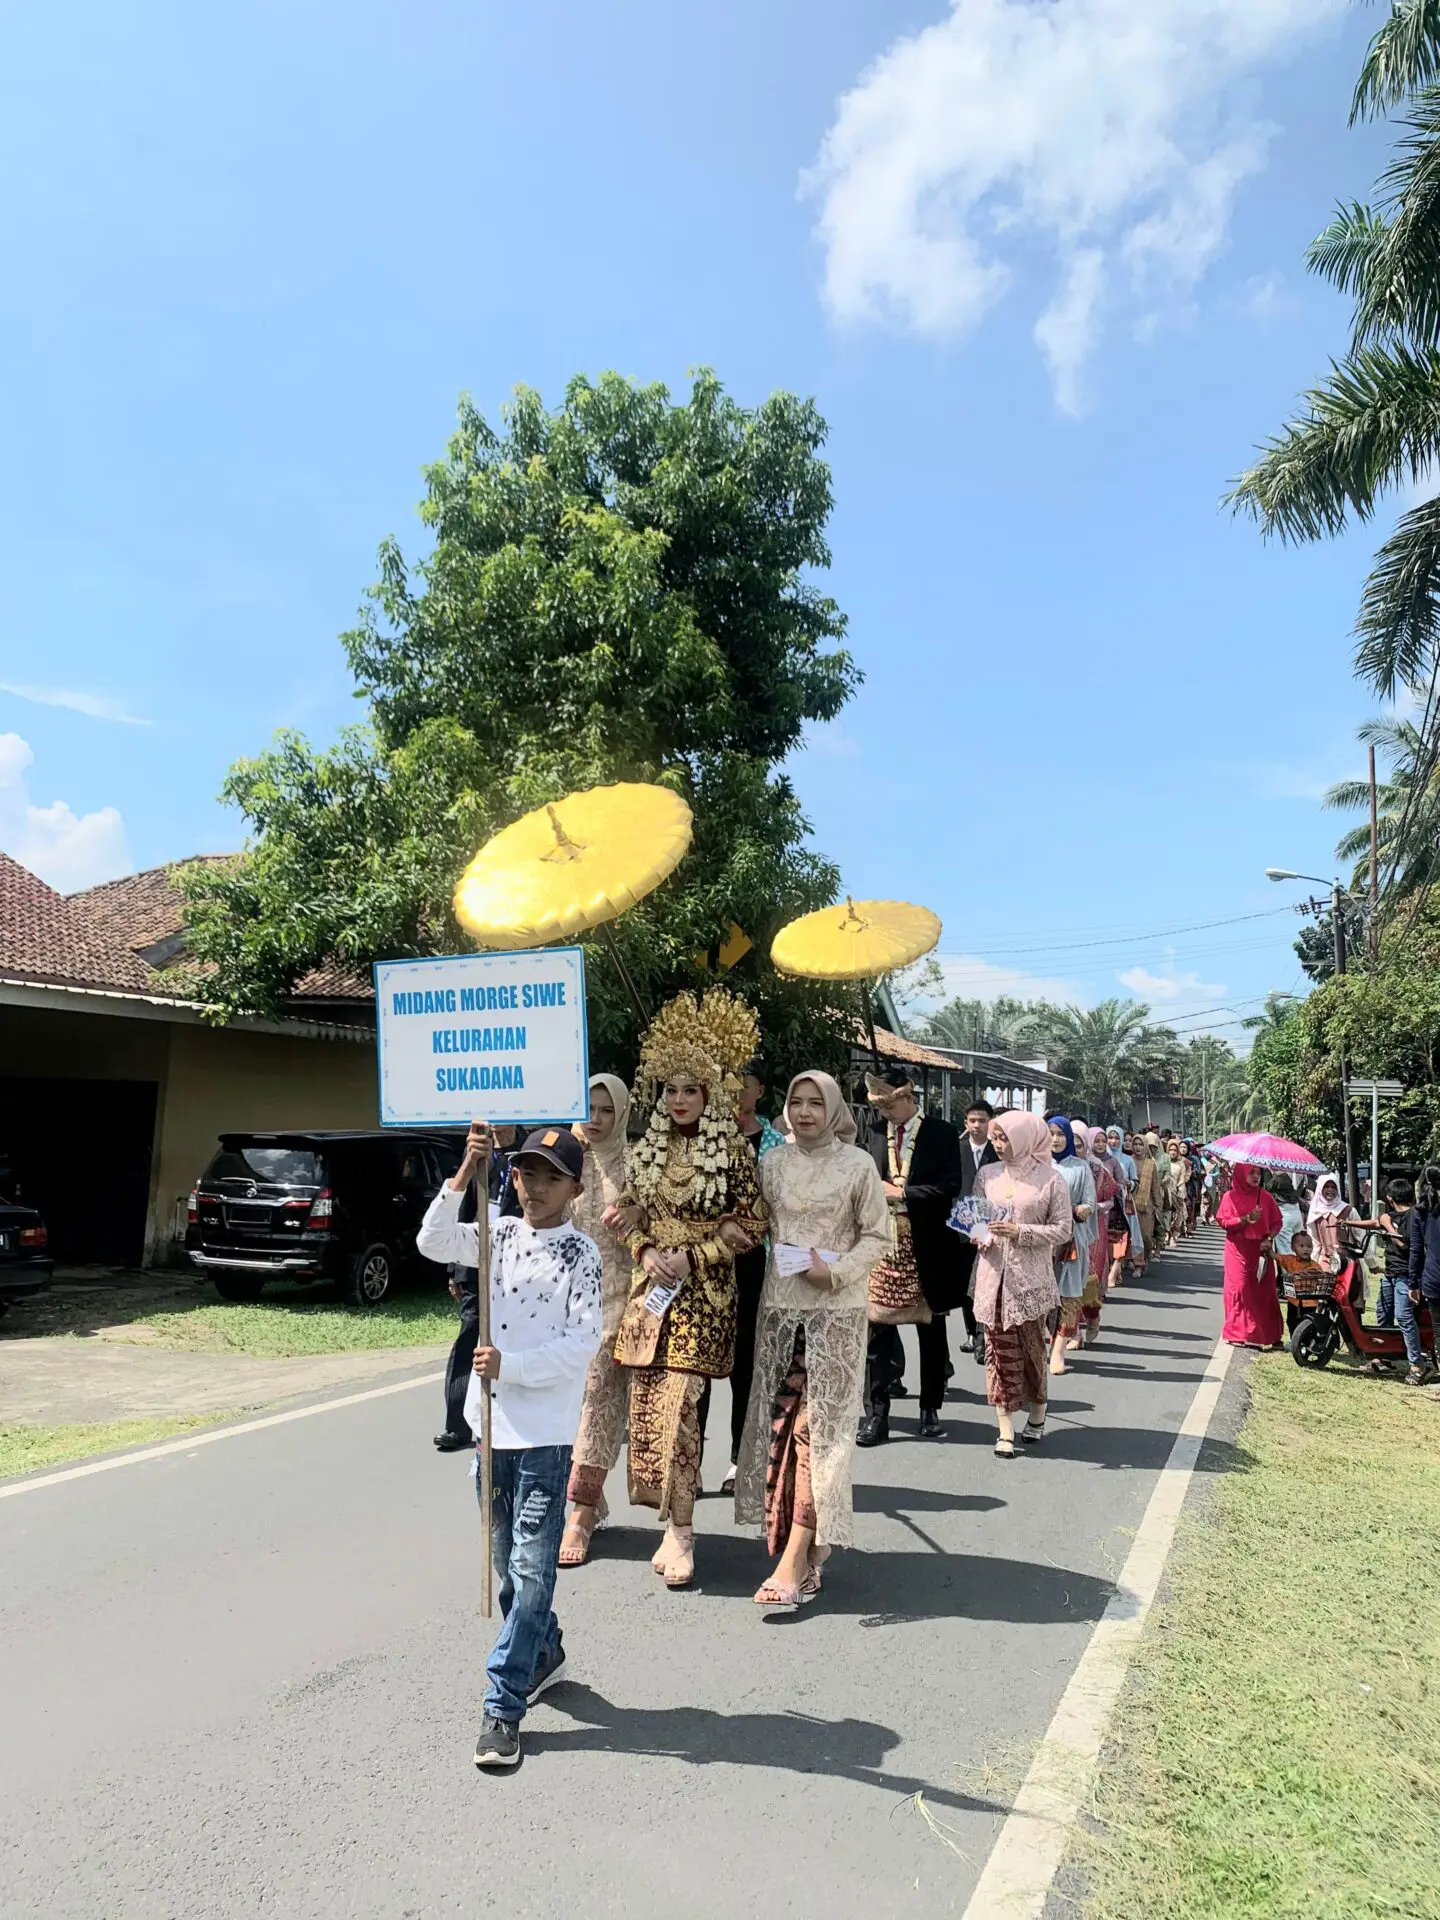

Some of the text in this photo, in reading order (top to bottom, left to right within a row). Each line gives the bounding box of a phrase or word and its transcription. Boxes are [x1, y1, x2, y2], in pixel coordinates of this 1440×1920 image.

[393, 982, 566, 1015] MIDANG MORGE SIWE
[432, 1026, 526, 1053] KELURAHAN
[436, 1066, 524, 1091] SUKADANA
[646, 1283, 676, 1314] MAJ
